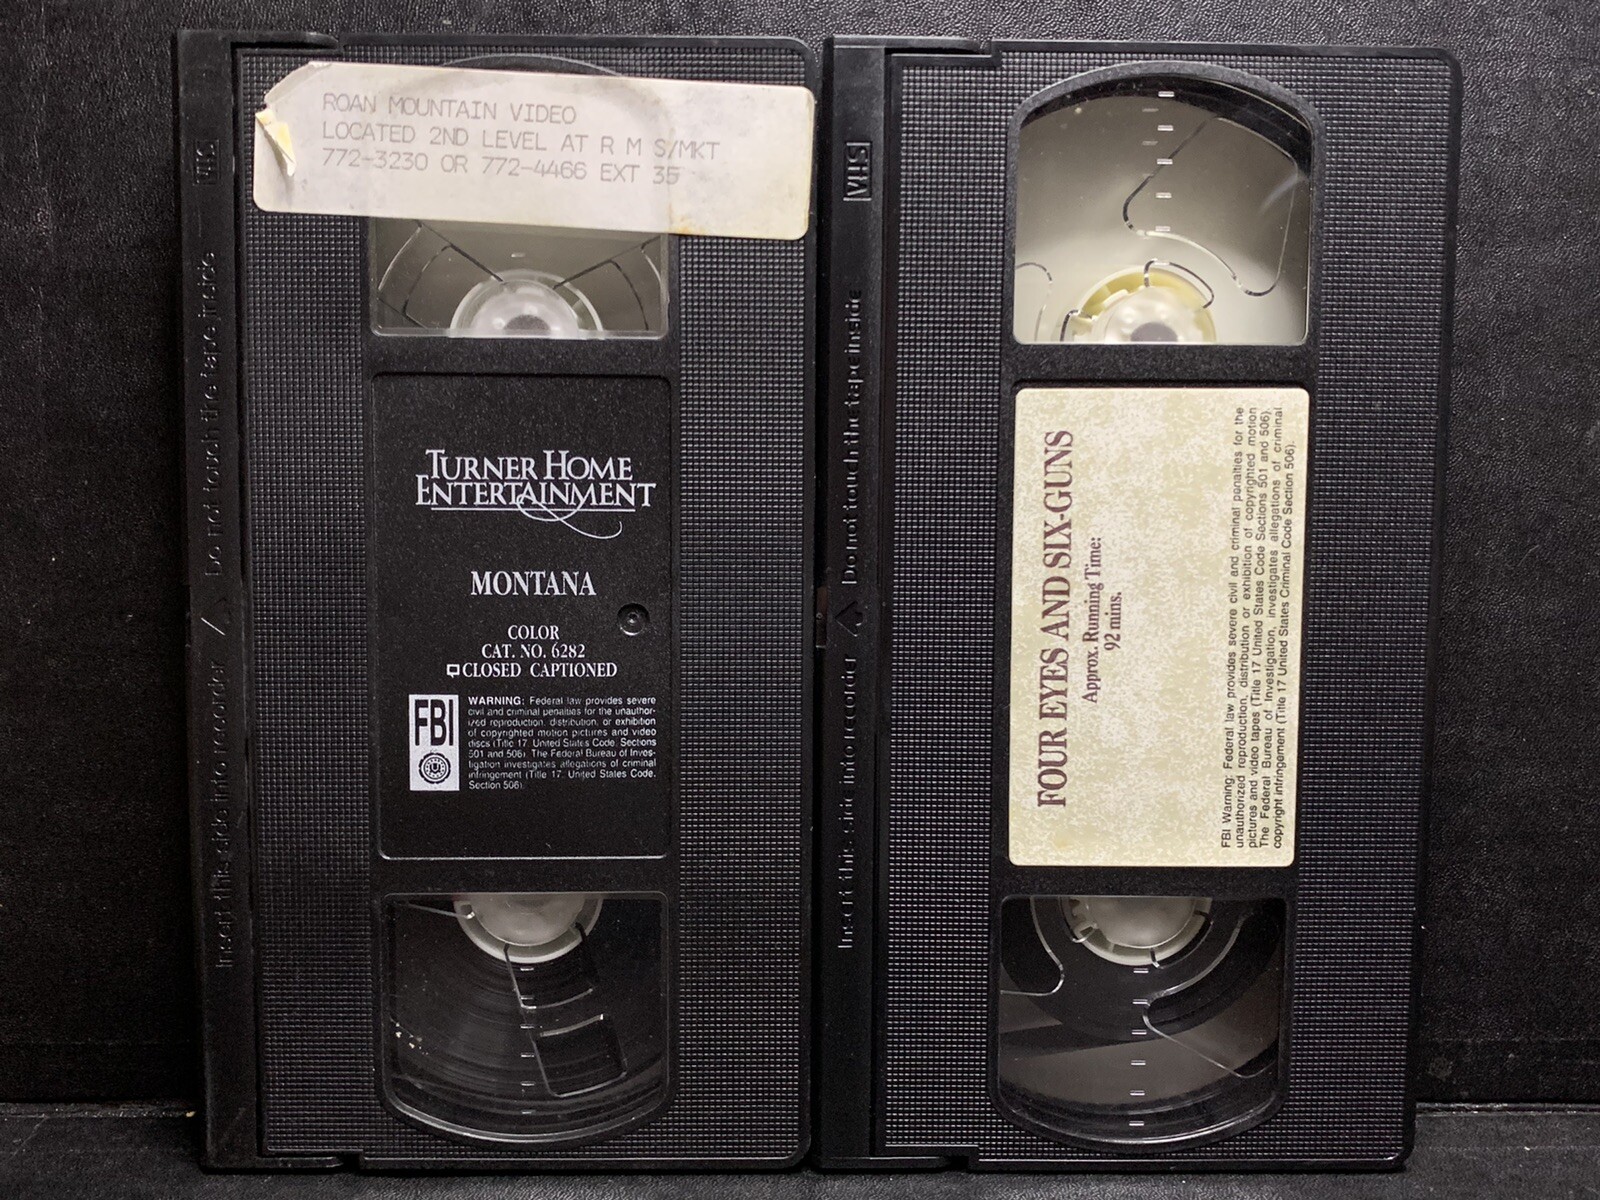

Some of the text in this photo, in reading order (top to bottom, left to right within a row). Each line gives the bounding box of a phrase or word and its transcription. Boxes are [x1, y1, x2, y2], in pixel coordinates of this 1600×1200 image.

[322, 92, 577, 125] ROAN MOUNTAIN VIDEO
[322, 120, 721, 161] LOCATED 2ND LEVEL AT R M S/MKT
[322, 146, 681, 187] 772-3230 OR 772-4466 EXT 35
[847, 146, 869, 197] VHS
[1247, 407, 1257, 447] motion
[1273, 407, 1283, 454] criminal
[1271, 460, 1282, 472] of
[1244, 453, 1258, 521] copyrighted
[1268, 479, 1283, 542] allegations
[1243, 527, 1253, 539] of
[470, 569, 597, 597] MONTANA
[1241, 545, 1255, 601] exhibition
[1266, 549, 1281, 618] investigates
[507, 624, 560, 640] COLOR
[1036, 430, 1074, 808] FOUR EYES AND SIX-GUNS
[1082, 537, 1105, 704] Approx. Running Time:
[1103, 591, 1123, 651] 92 mins.
[1220, 407, 1244, 849] FBI Warning: Federal law provides severe civil and criminal penalties for the
[1241, 606, 1251, 619] or
[1247, 410, 1272, 849] pictures and video tapes (Title 17 United States Code Sections 501 and 506).
[481, 642, 586, 659] CAT. NO. 6282
[1238, 625, 1250, 689] distribution
[1273, 441, 1296, 850] copyright infringement (Title 17 United States Criminal Code Section 506).
[462, 662, 618, 678] CLOSED CAPTIONED
[467, 695, 525, 706] WARNING:
[529, 696, 563, 706] Federal
[585, 696, 623, 706] provides
[626, 696, 657, 705] severe
[467, 708, 485, 716] civil
[486, 707, 504, 716] and
[506, 707, 540, 717] criminal
[584, 706, 596, 716] for
[598, 706, 613, 716] the
[614, 706, 656, 718] unauthor-
[1263, 709, 1277, 721] of
[414, 699, 454, 747] FBI
[467, 727, 657, 740] of copyrighted motion pictures and video
[602, 718, 612, 726] or
[614, 716, 656, 726] exhibition
[468, 749, 484, 759] 501
[487, 749, 504, 758] and
[531, 748, 548, 759] The
[550, 748, 584, 758] Federal
[585, 748, 617, 758] Bureau
[618, 748, 628, 758] of
[629, 748, 656, 760] Inves-
[492, 738, 514, 748] (Title
[532, 738, 561, 748] United
[562, 737, 590, 748] States
[620, 737, 657, 747] Sections
[1261, 727, 1273, 769] Bureau
[468, 769, 522, 782] infringement
[525, 769, 547, 779] (Title
[567, 769, 596, 779] United
[599, 769, 627, 779] States
[504, 760, 557, 771] investigates
[610, 758, 619, 768] of
[621, 758, 657, 770] criminal
[468, 780, 501, 790] Section
[1260, 775, 1275, 820] Federal
[1235, 774, 1246, 849] unauthorized
[1259, 826, 1270, 848] The
